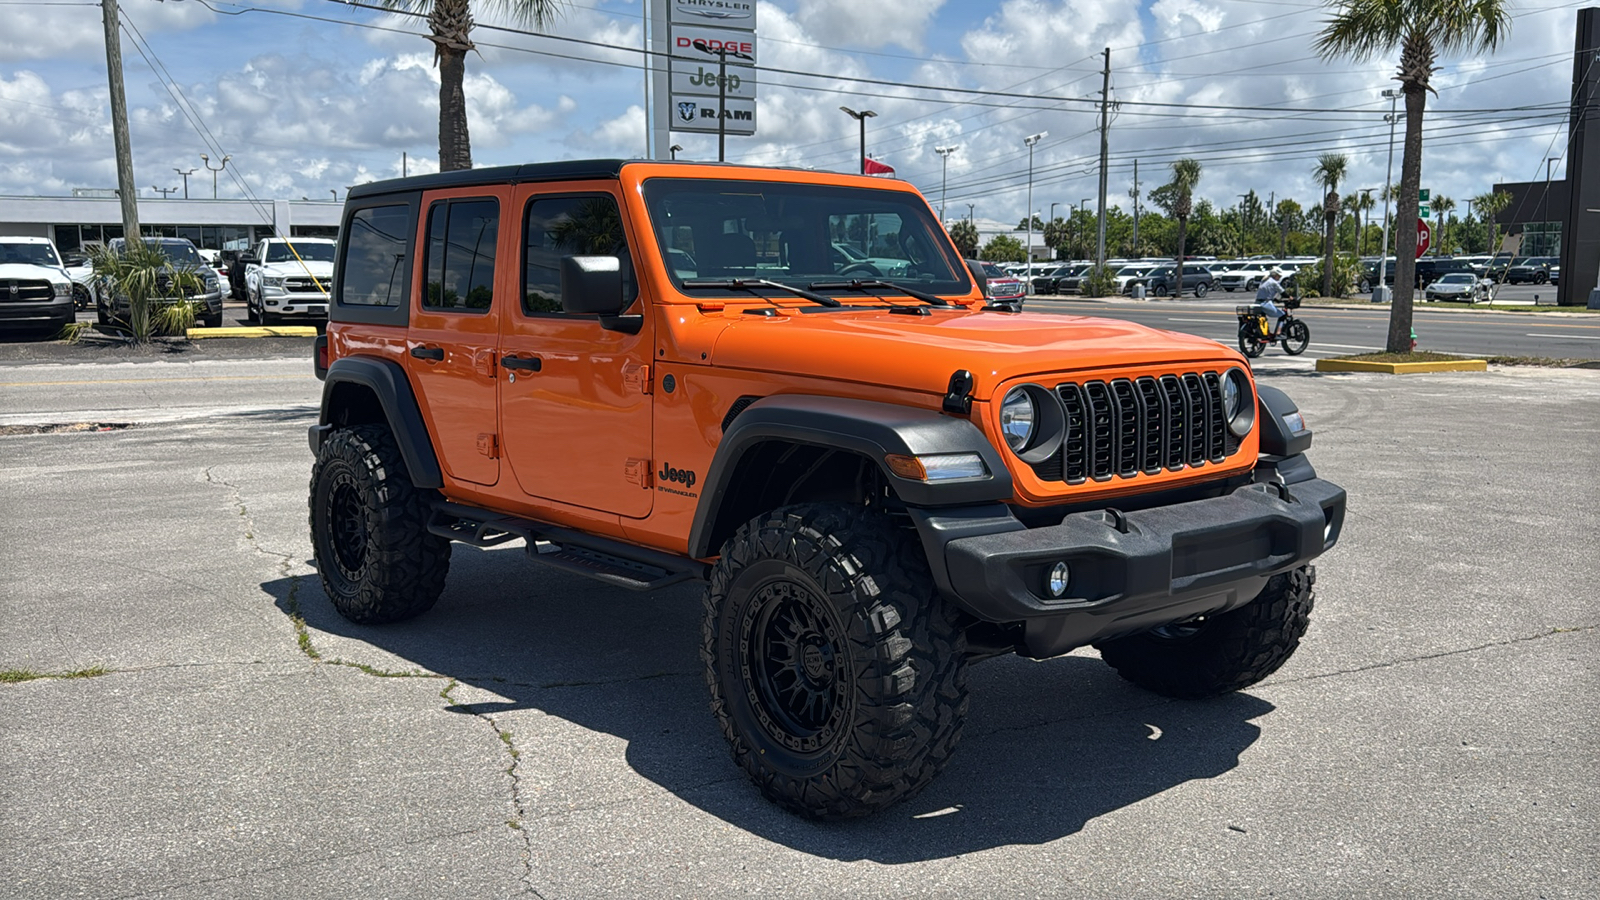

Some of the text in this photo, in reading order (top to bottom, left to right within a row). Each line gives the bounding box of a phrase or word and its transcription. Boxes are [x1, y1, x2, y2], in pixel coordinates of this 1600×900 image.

[677, 0, 750, 10] CHRYSLER
[690, 67, 740, 92] Jeep
[701, 108, 752, 120] RAM
[659, 462, 696, 488] Jeep
